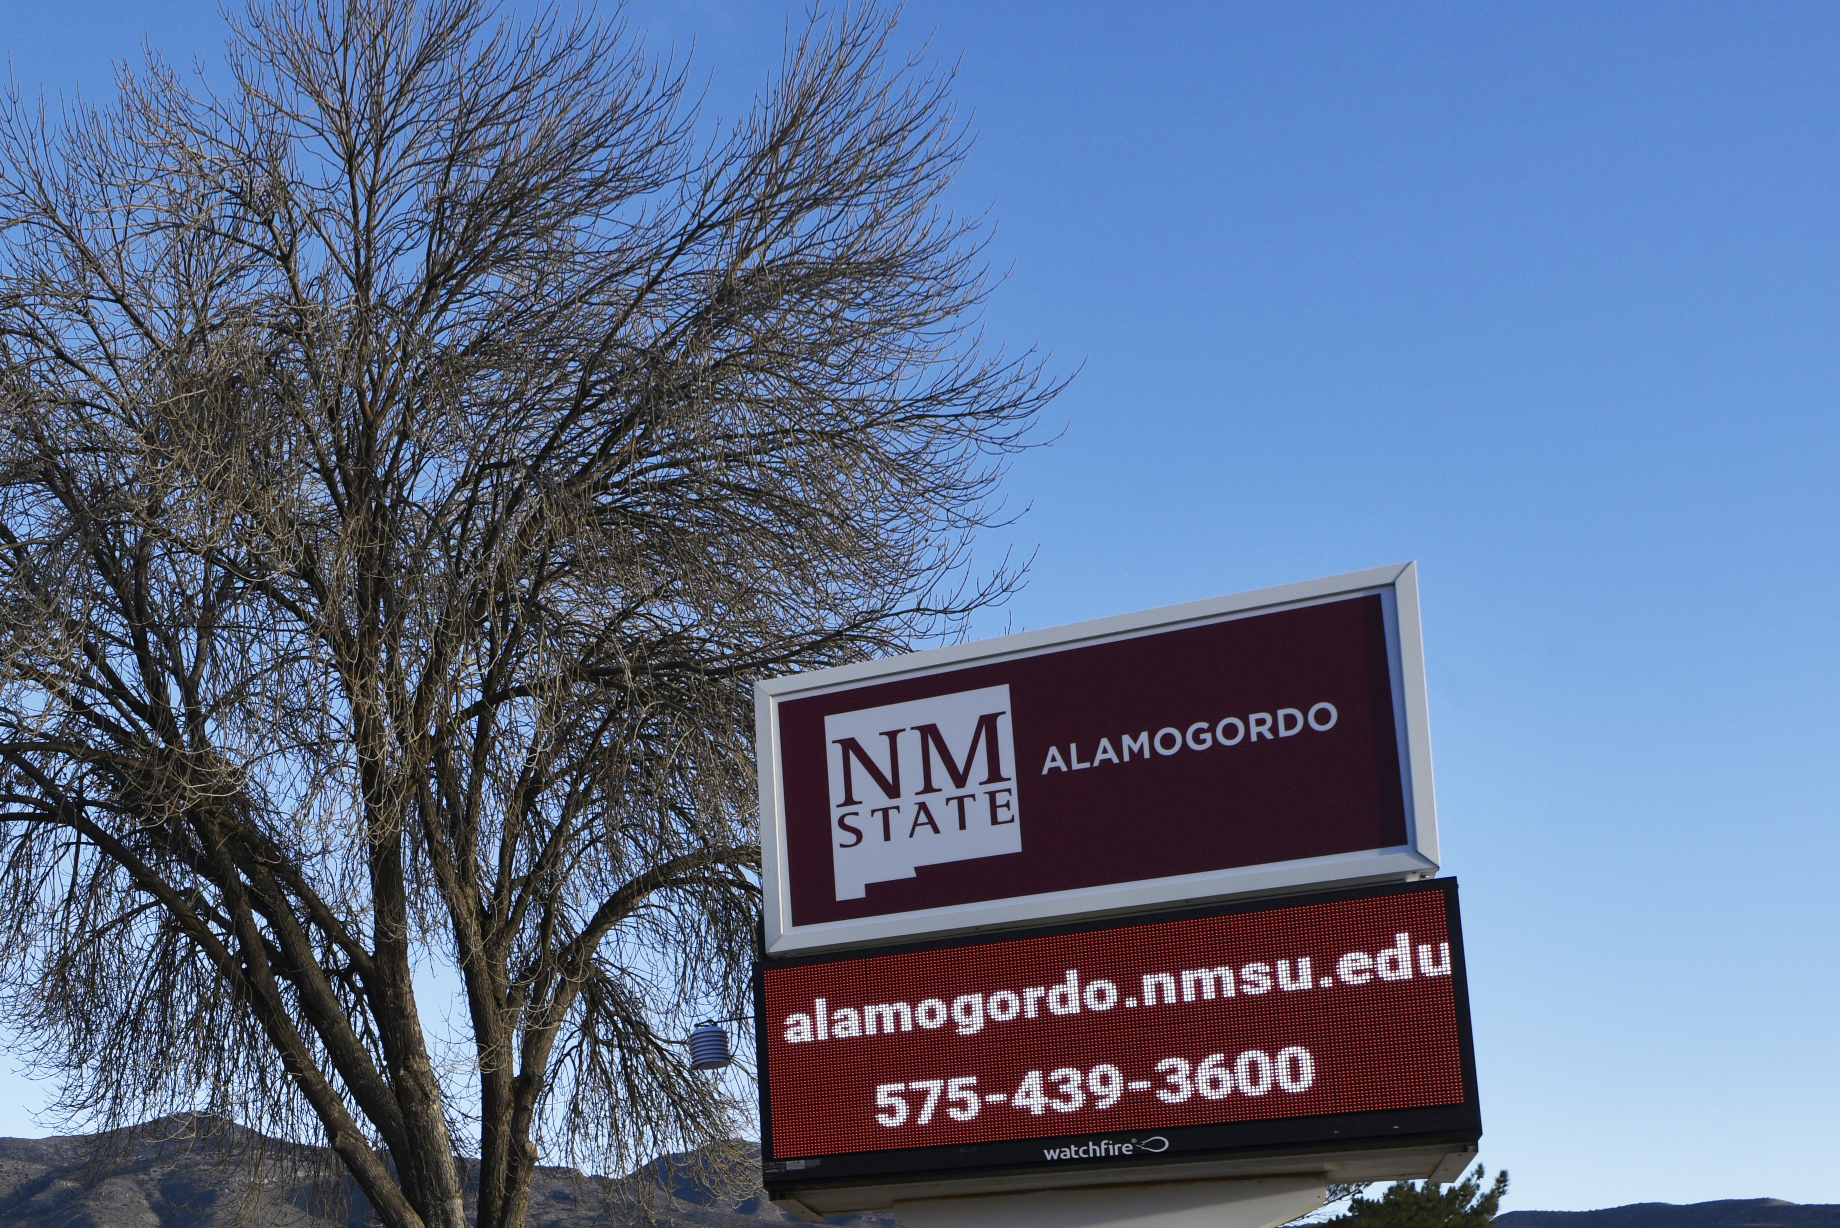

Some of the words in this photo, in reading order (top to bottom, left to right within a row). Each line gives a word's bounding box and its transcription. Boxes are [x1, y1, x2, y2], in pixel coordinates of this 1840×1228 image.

[832, 711, 1012, 808] NM
[1041, 701, 1339, 776] ALAMOGORDO
[837, 788, 1016, 848] STATE
[783, 932, 1452, 1045] alamogordo.nmsu.edu
[875, 1045, 1316, 1128] 575-439-3600
[1043, 1140, 1134, 1160] watchfire
